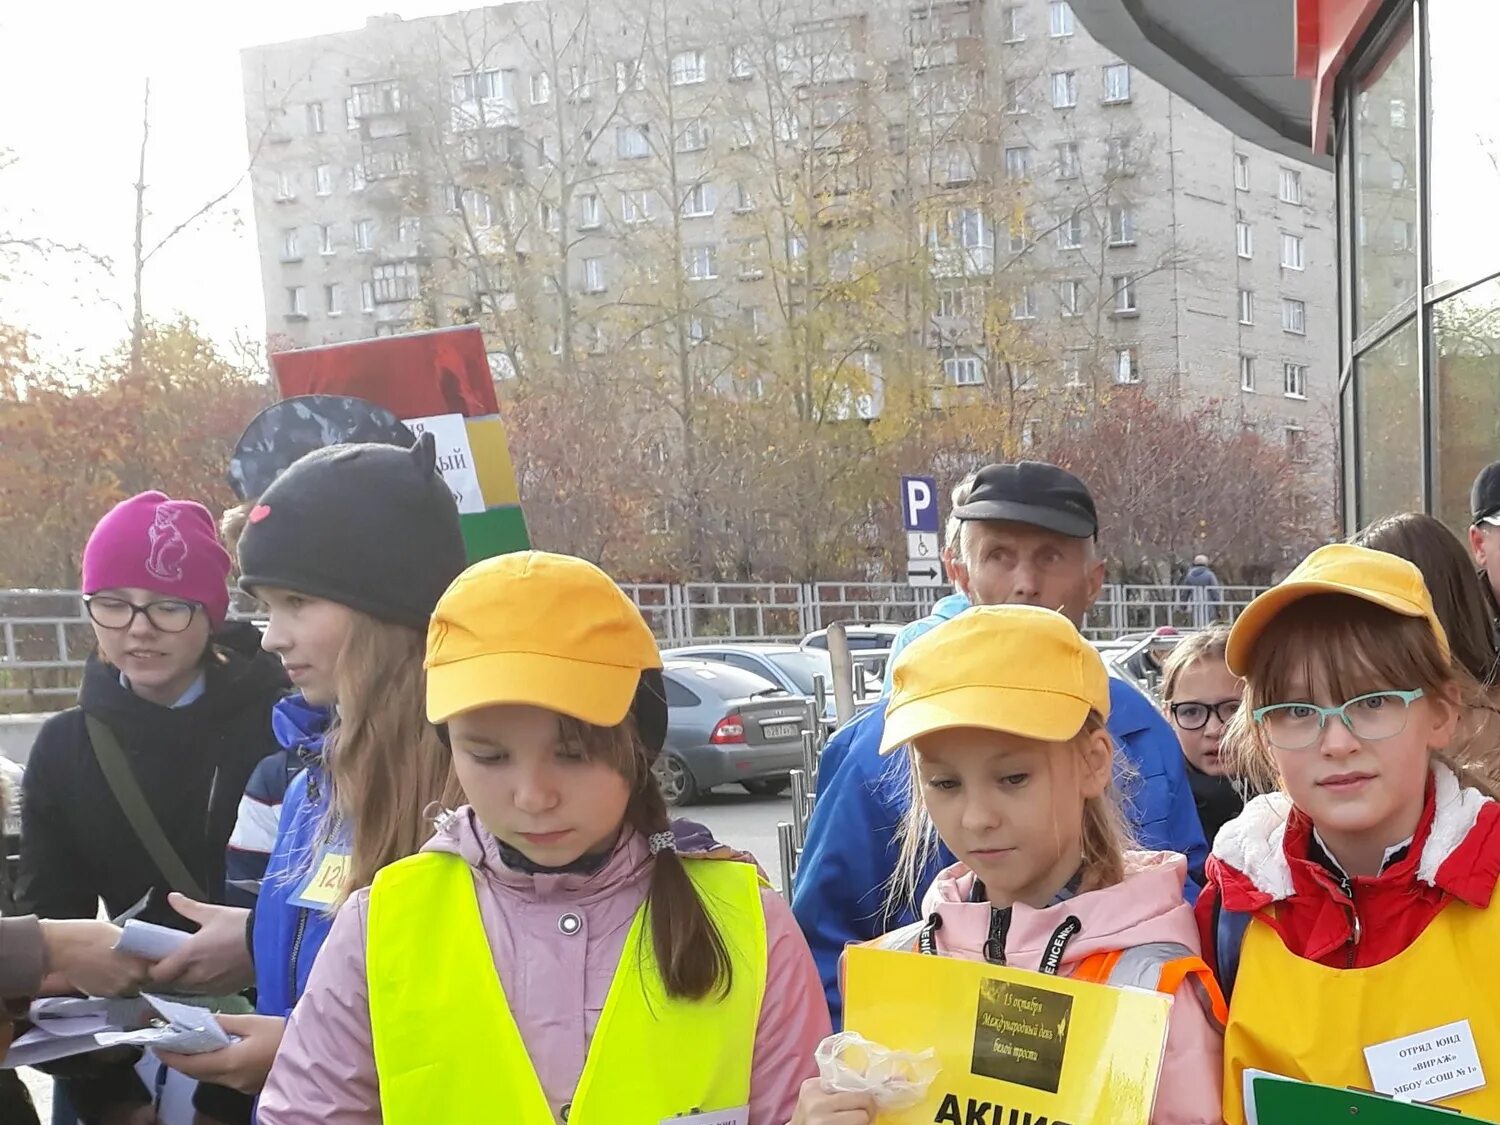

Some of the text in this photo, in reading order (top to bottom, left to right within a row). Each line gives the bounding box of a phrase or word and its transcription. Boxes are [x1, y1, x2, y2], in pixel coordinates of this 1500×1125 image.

[1003, 992, 1043, 1017] 15 октября
[982, 1012, 1053, 1040] Международный день
[993, 1037, 1038, 1062] белой трости
[1399, 1034, 1461, 1058] ОТРЯД ЮИД
[1412, 1053, 1457, 1071] «ВИРАЖ»
[1393, 1080, 1422, 1095] МБОУ
[1425, 1072, 1453, 1086] «СОШ
